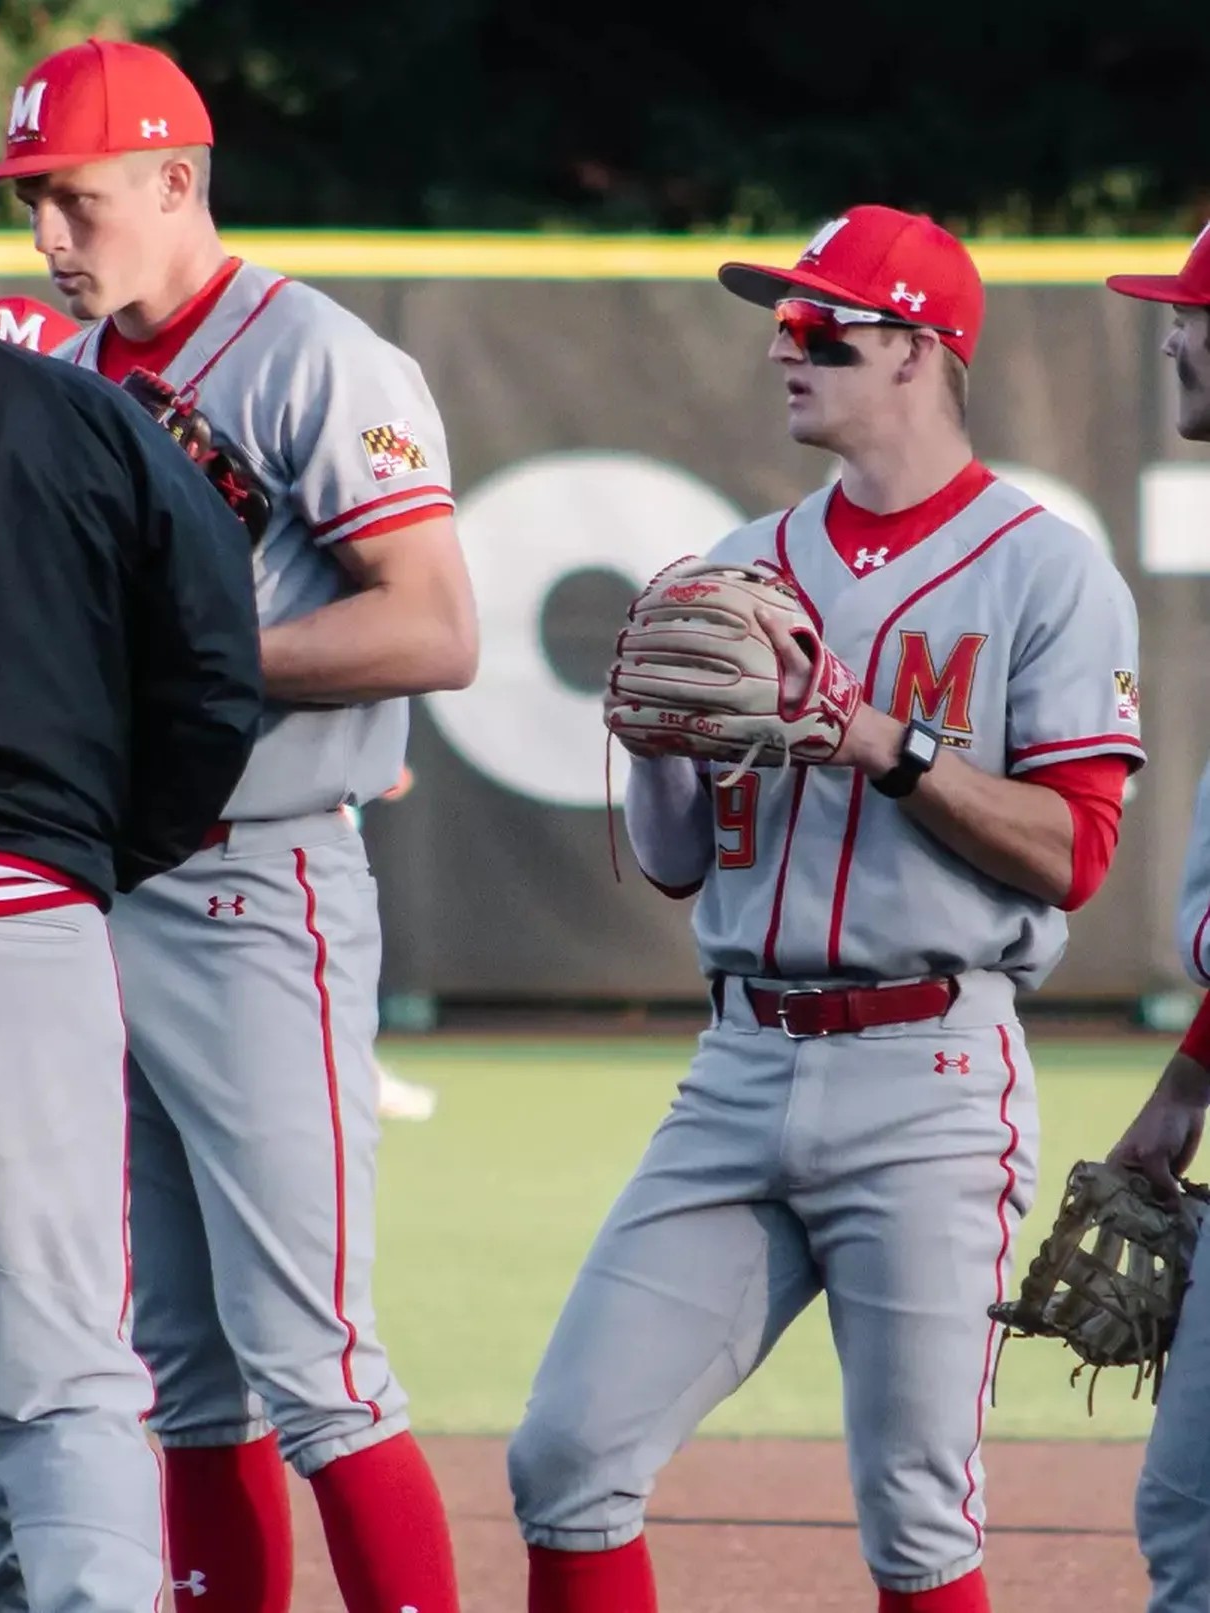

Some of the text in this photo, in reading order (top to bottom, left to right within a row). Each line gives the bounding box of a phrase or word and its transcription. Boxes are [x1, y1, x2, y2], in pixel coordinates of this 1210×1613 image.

[695, 717, 724, 736] OUT
[886, 629, 989, 734] M
[716, 770, 761, 870] 9
